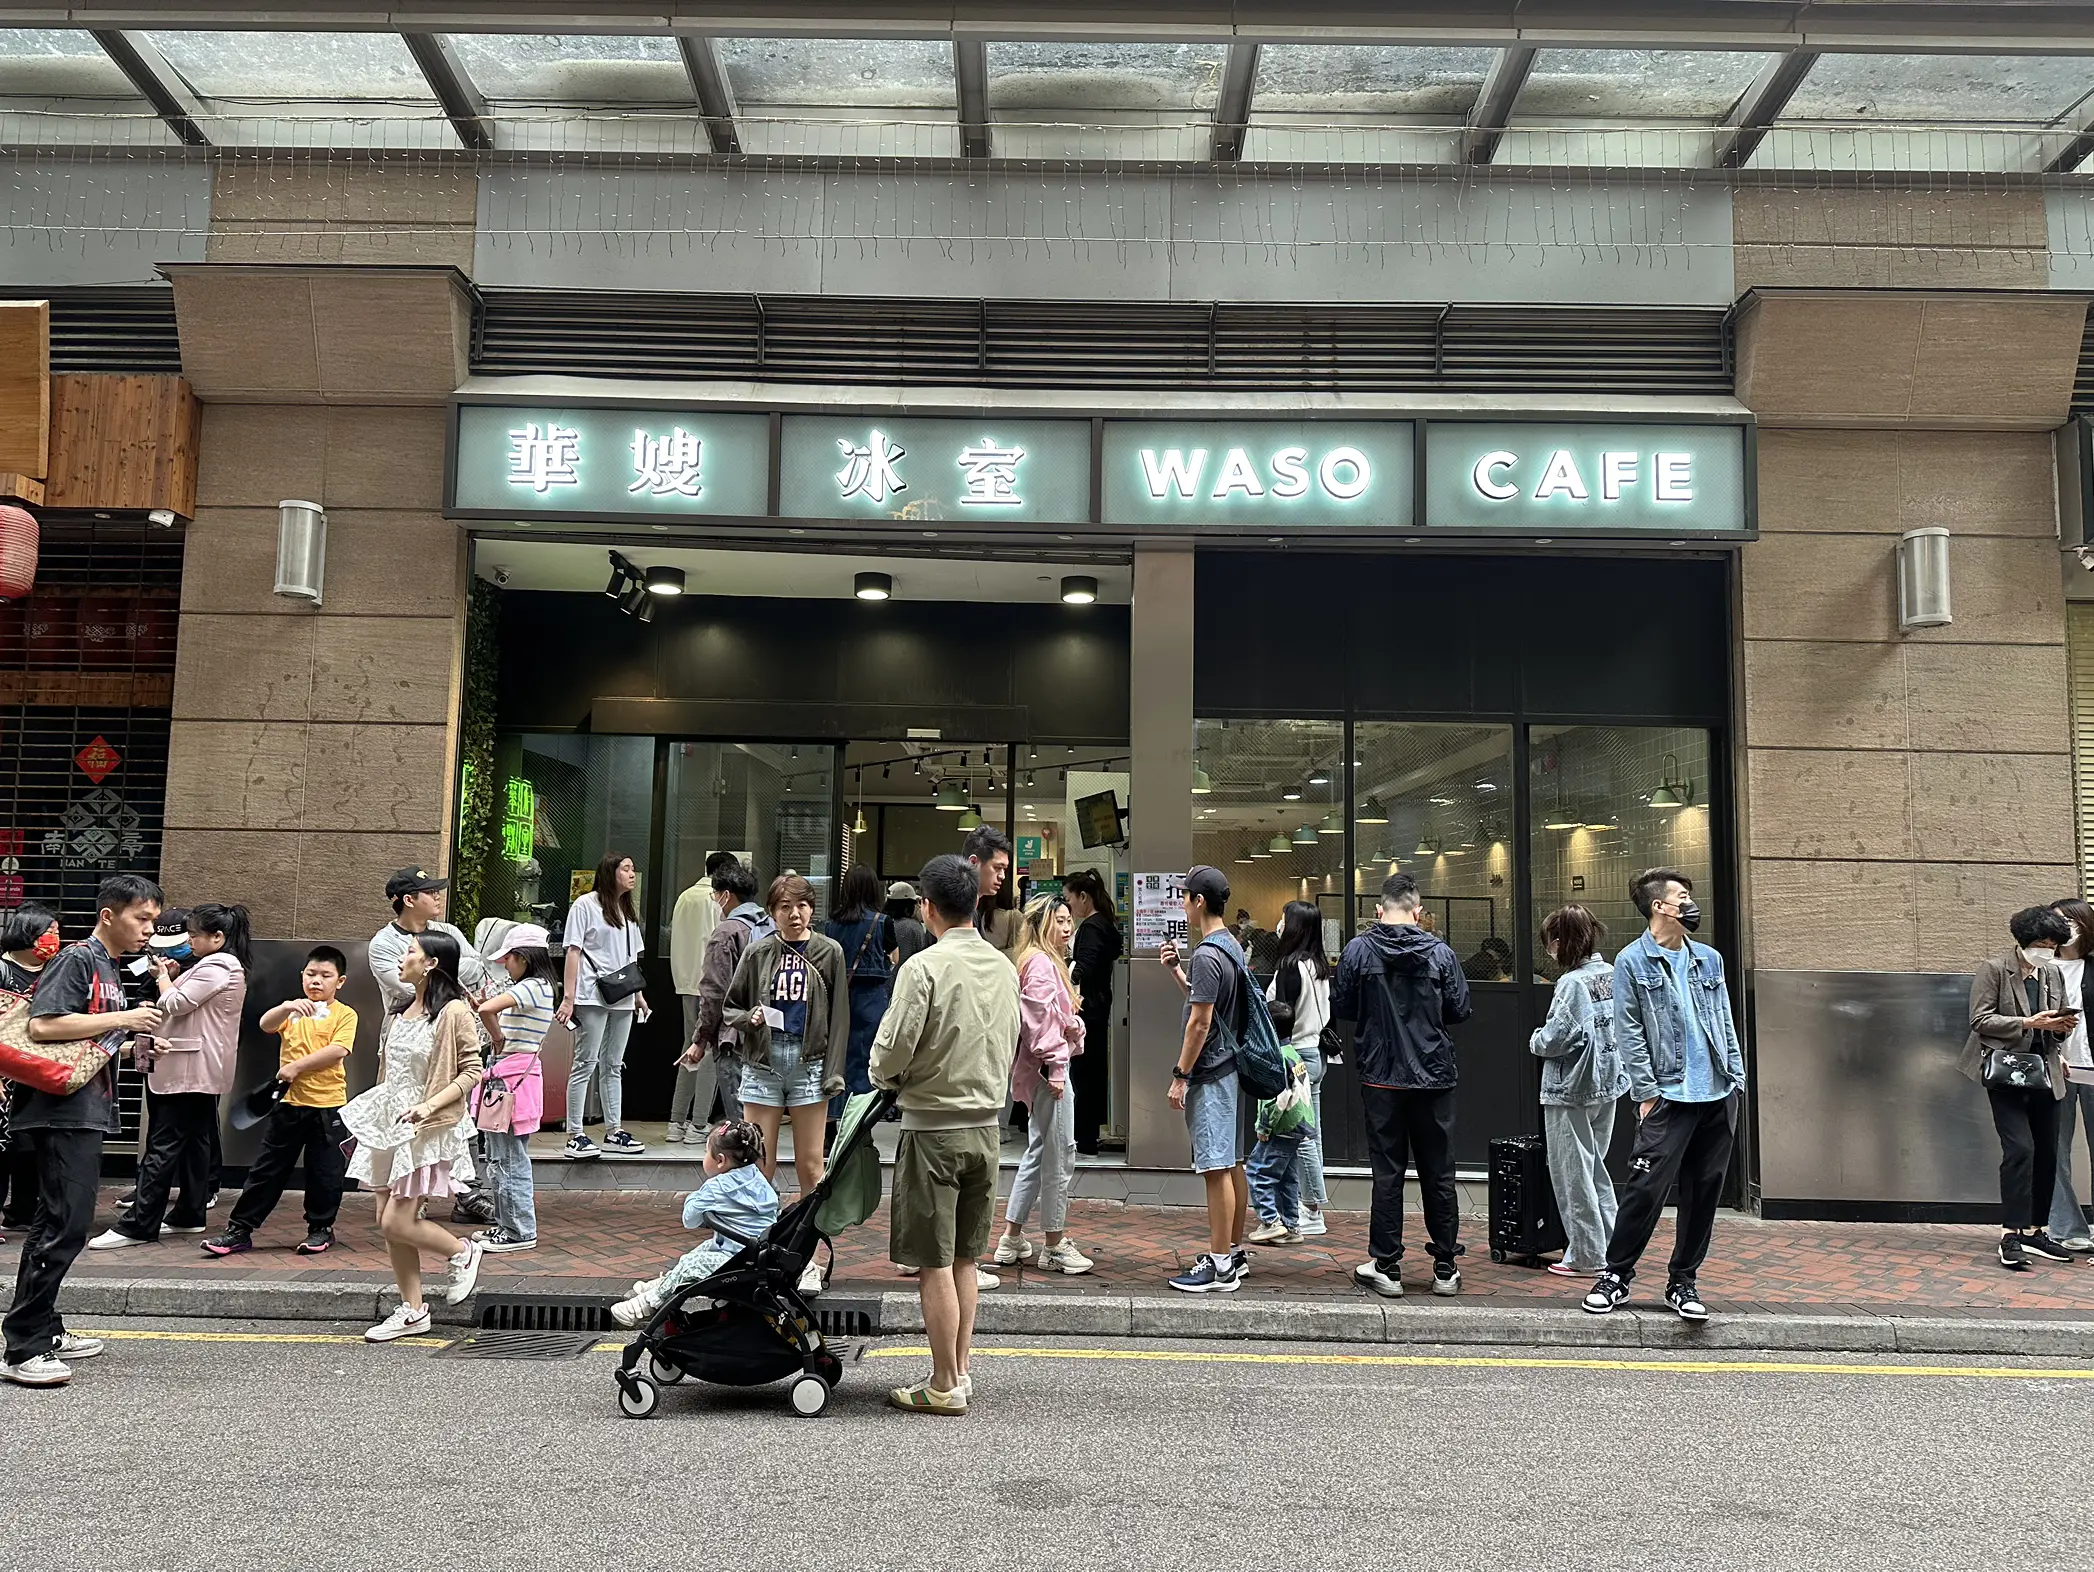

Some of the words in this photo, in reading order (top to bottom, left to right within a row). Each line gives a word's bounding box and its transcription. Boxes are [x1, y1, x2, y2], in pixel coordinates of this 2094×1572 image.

[507, 422, 1025, 504] 華嫂冰室
[1139, 447, 1371, 499] WASO
[1473, 450, 1693, 500] CAFE
[156, 924, 182, 933] SPACE
